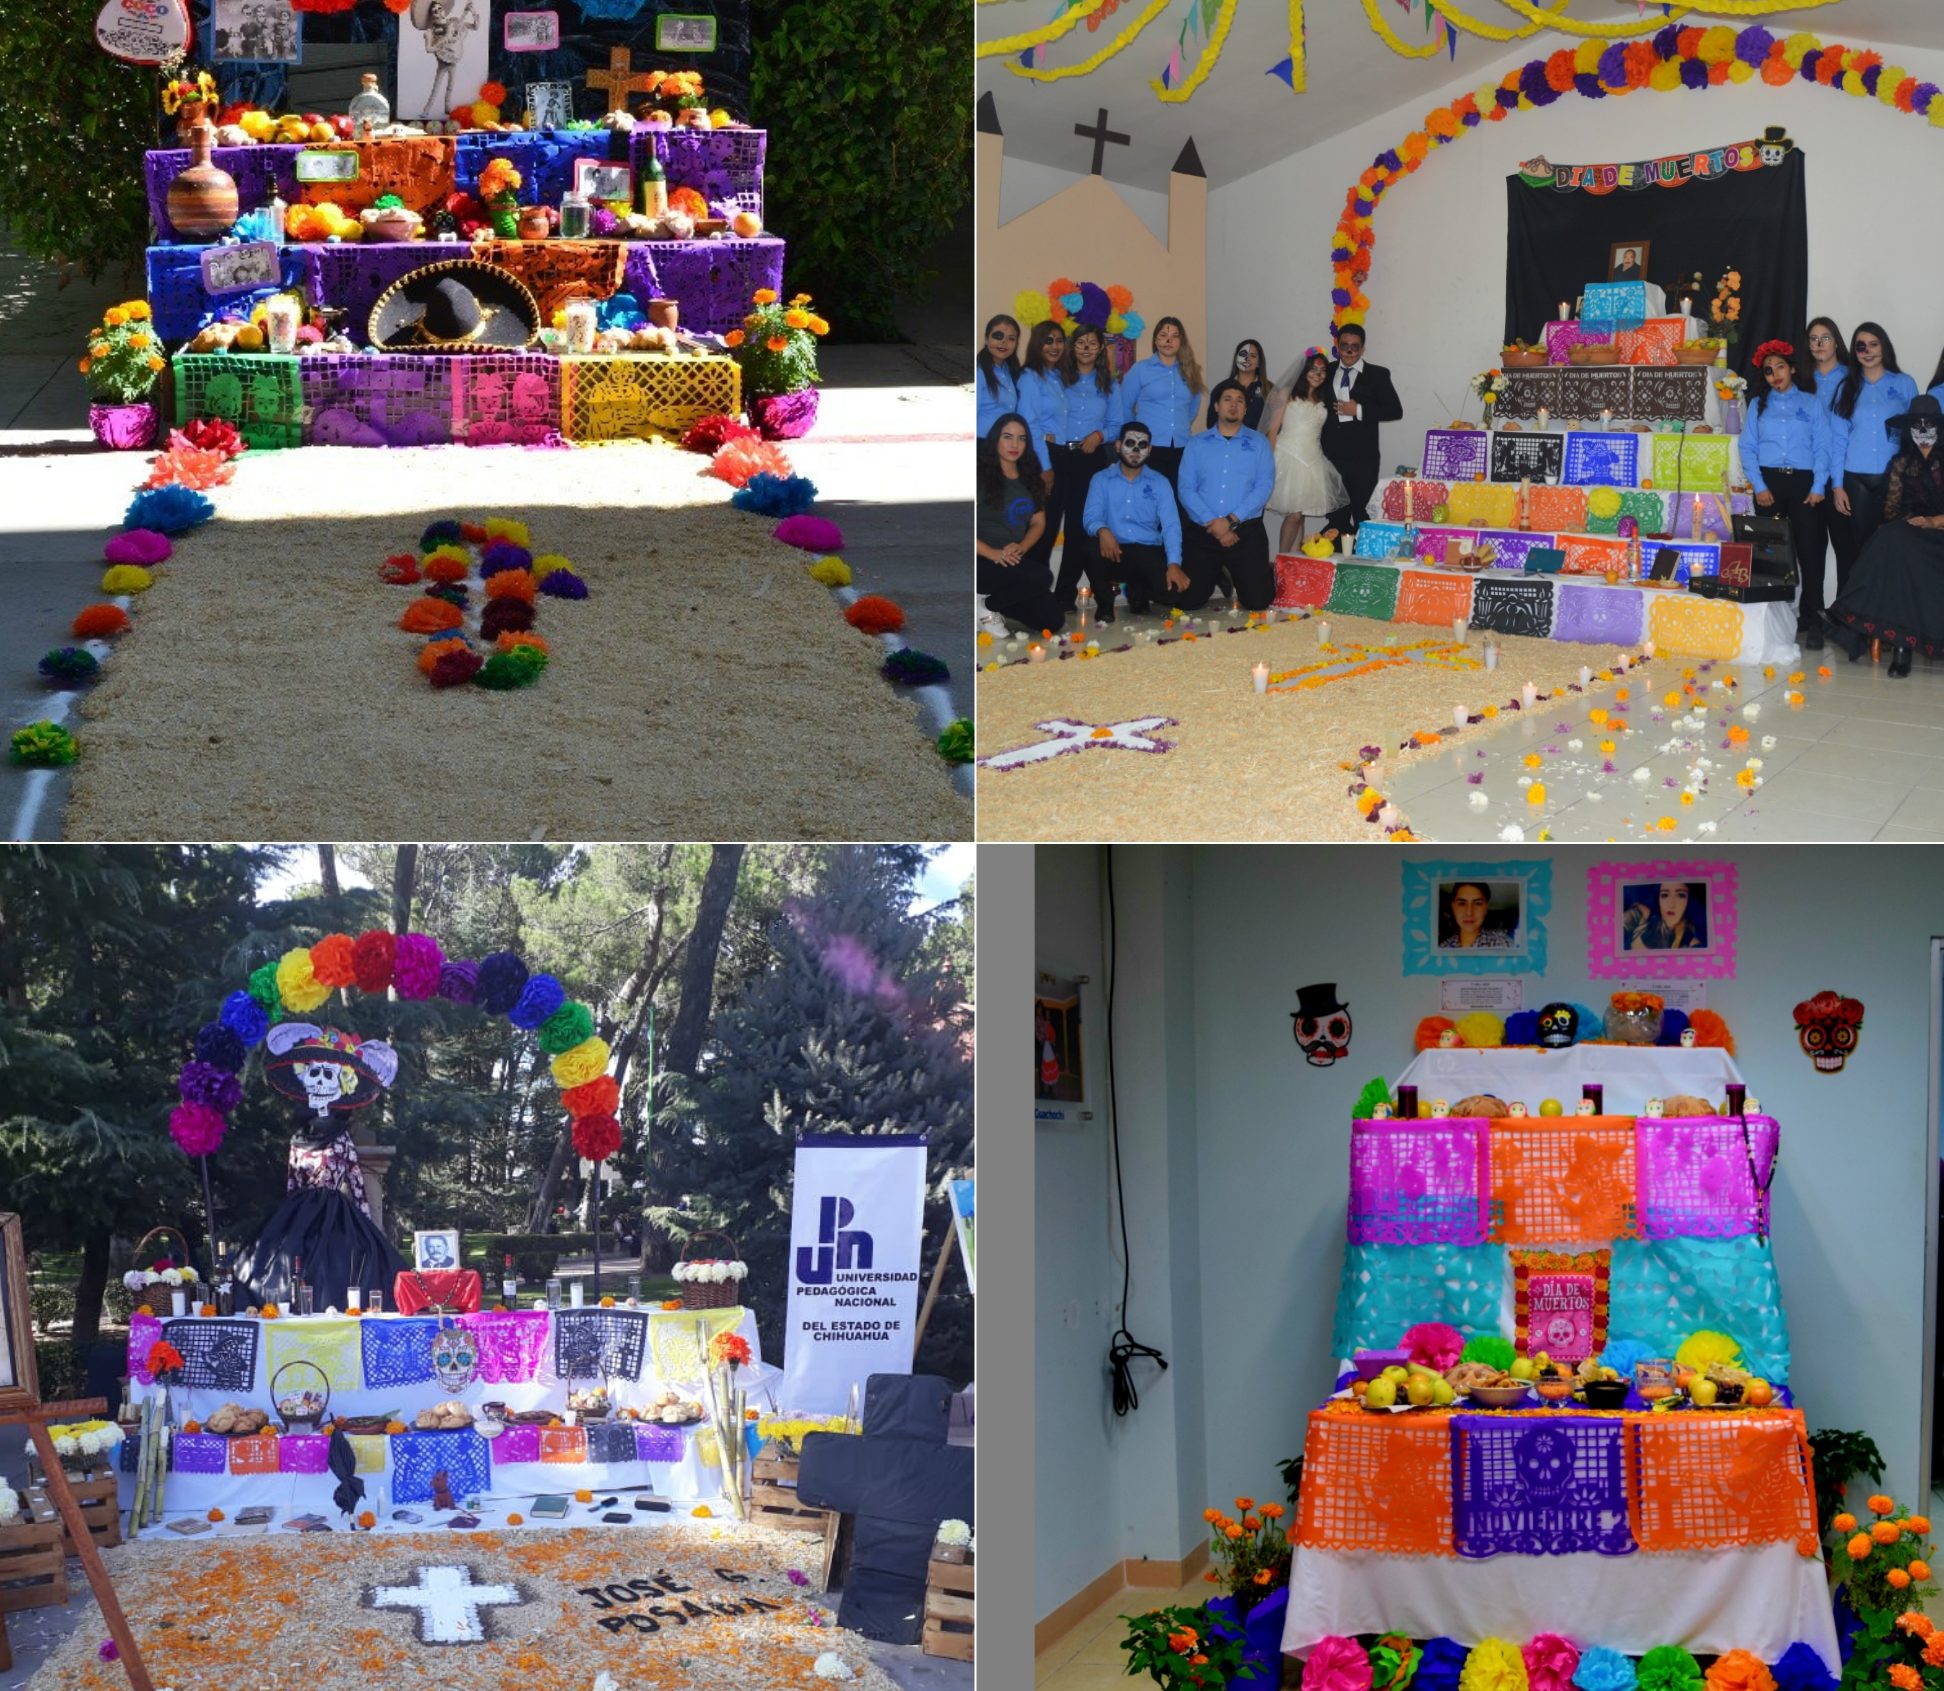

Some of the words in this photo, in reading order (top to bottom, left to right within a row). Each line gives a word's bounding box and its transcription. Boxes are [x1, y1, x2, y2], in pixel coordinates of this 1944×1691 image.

[1556, 166, 1596, 188] DIA
[1603, 165, 1635, 187] DE
[1645, 146, 1755, 186] MUERTOS
[1522, 372, 1552, 380] MUERTOS
[1590, 372, 1623, 380] MUERTOS
[836, 1272, 917, 1283] UNIVERSIDAD
[796, 1285, 877, 1296] PEDAGÓGICA
[1543, 1280, 1563, 1297] DÍA
[1566, 1283, 1580, 1296] DE
[834, 1297, 897, 1307] NACIONAL
[1533, 1296, 1590, 1312] MUERTOS
[802, 1321, 827, 1331] DEL
[831, 1321, 881, 1331] ESTADO
[884, 1320, 901, 1330] DE
[813, 1332, 890, 1341] CHIHUAHUA
[1474, 1509, 1603, 1534] NOVIEMBRE
[577, 1568, 693, 1609] JOSÉ
